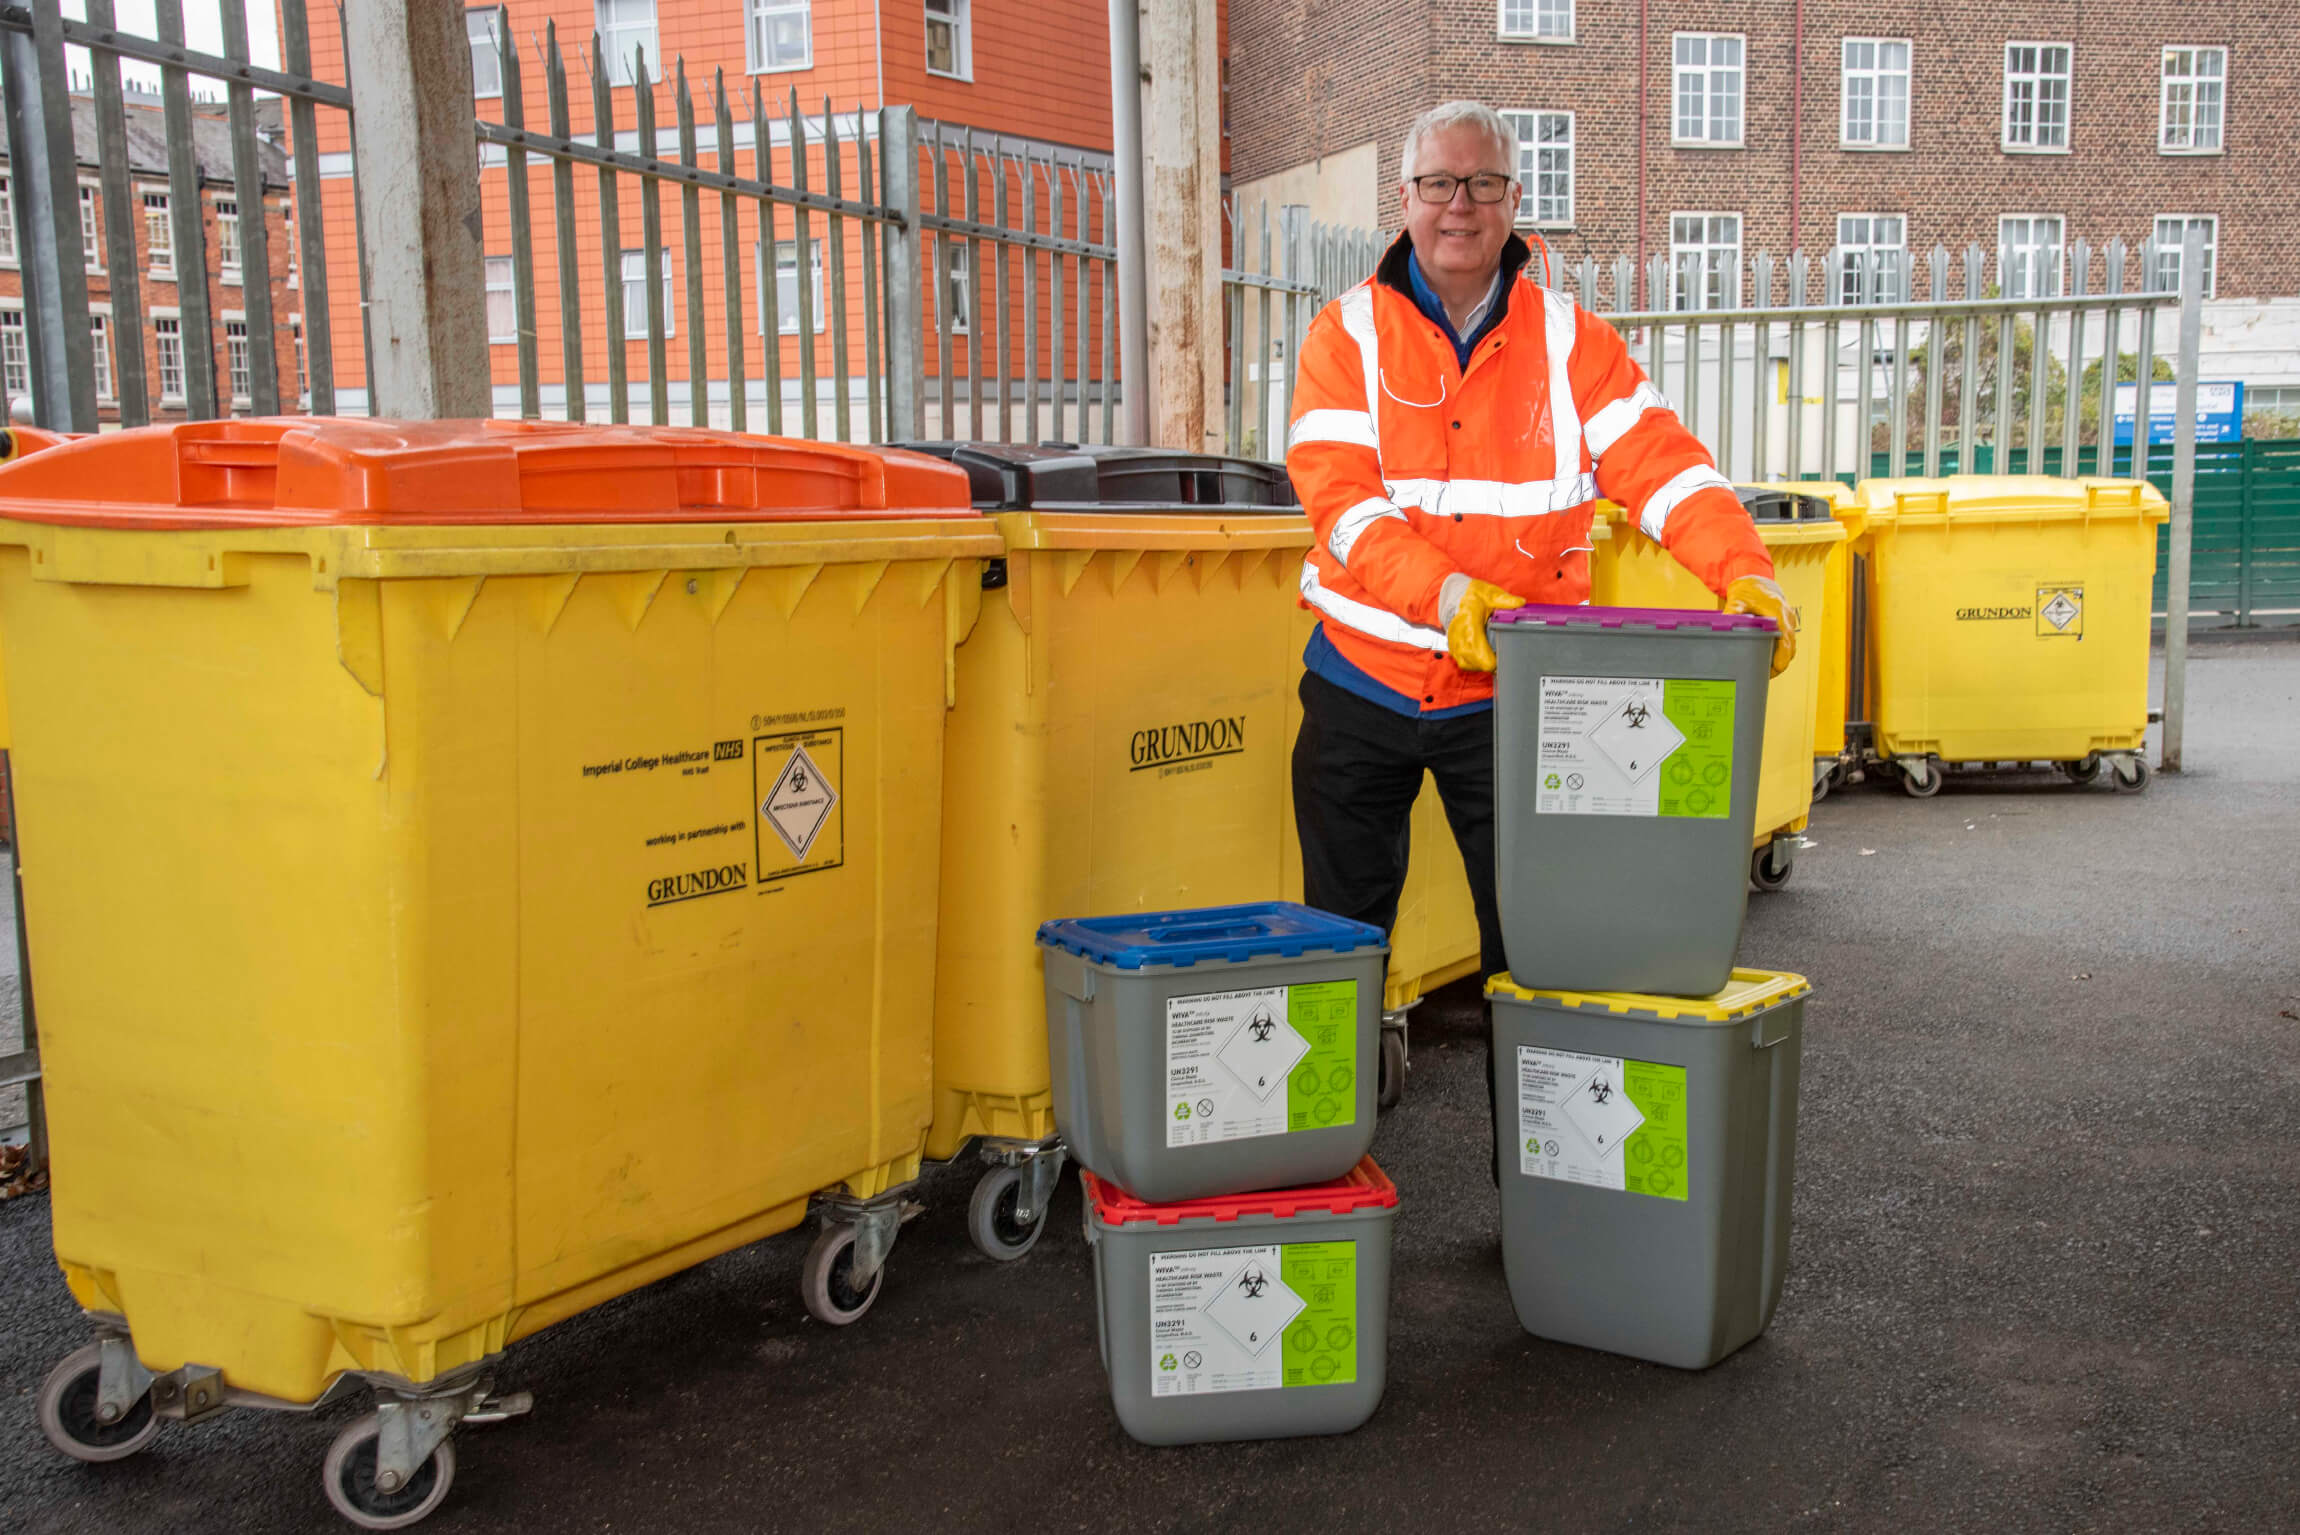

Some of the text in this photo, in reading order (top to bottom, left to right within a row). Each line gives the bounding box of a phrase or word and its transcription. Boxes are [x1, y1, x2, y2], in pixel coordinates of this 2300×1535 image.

[1956, 607, 2032, 619] GRUNDON
[1131, 716, 1245, 765] GRUNDON
[583, 740, 742, 778] Imperial College Healthcare NHS
[1630, 760, 1637, 770] 6
[646, 821, 745, 846] working in partnership with
[648, 862, 747, 901] GRUNDON
[1235, 991, 1251, 999] ABOVE
[1171, 1066, 1198, 1075] UN3291
[1259, 1076, 1265, 1086] 6
[1598, 1134, 1603, 1144] 6
[1156, 1319, 1185, 1328] UN3291
[1250, 1331, 1257, 1342] 6
